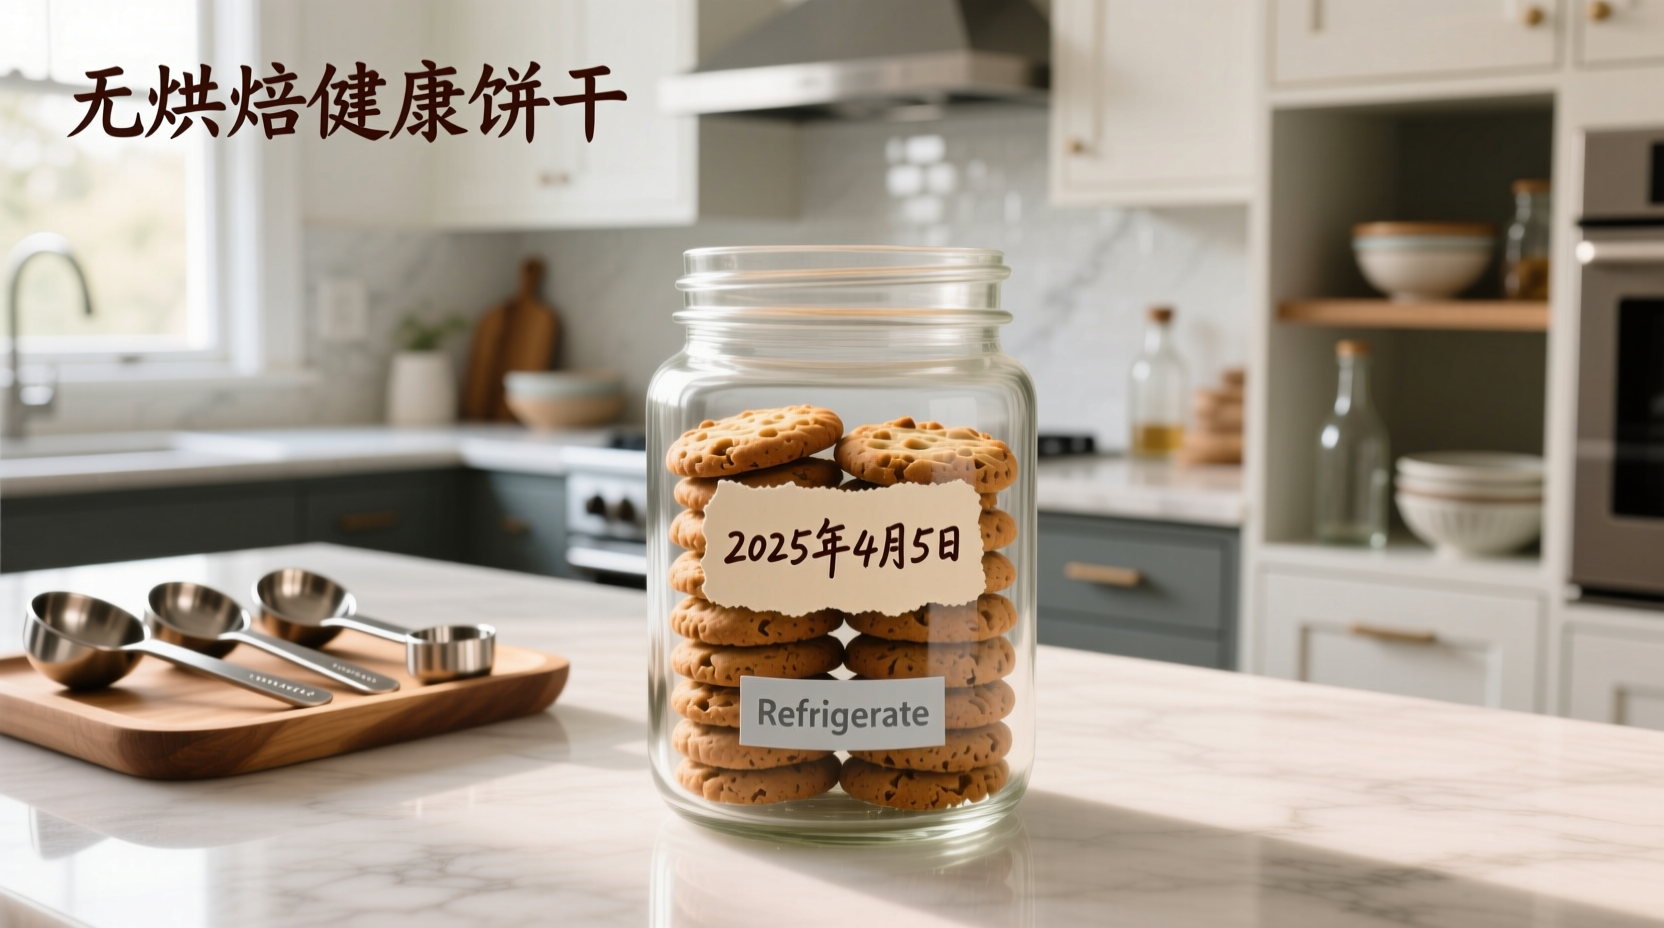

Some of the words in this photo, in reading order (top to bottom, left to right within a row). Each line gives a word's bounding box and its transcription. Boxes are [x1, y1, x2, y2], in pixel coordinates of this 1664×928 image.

[723, 518, 960, 578] 2025年4月5日
[758, 698, 930, 736] Refrigerate
